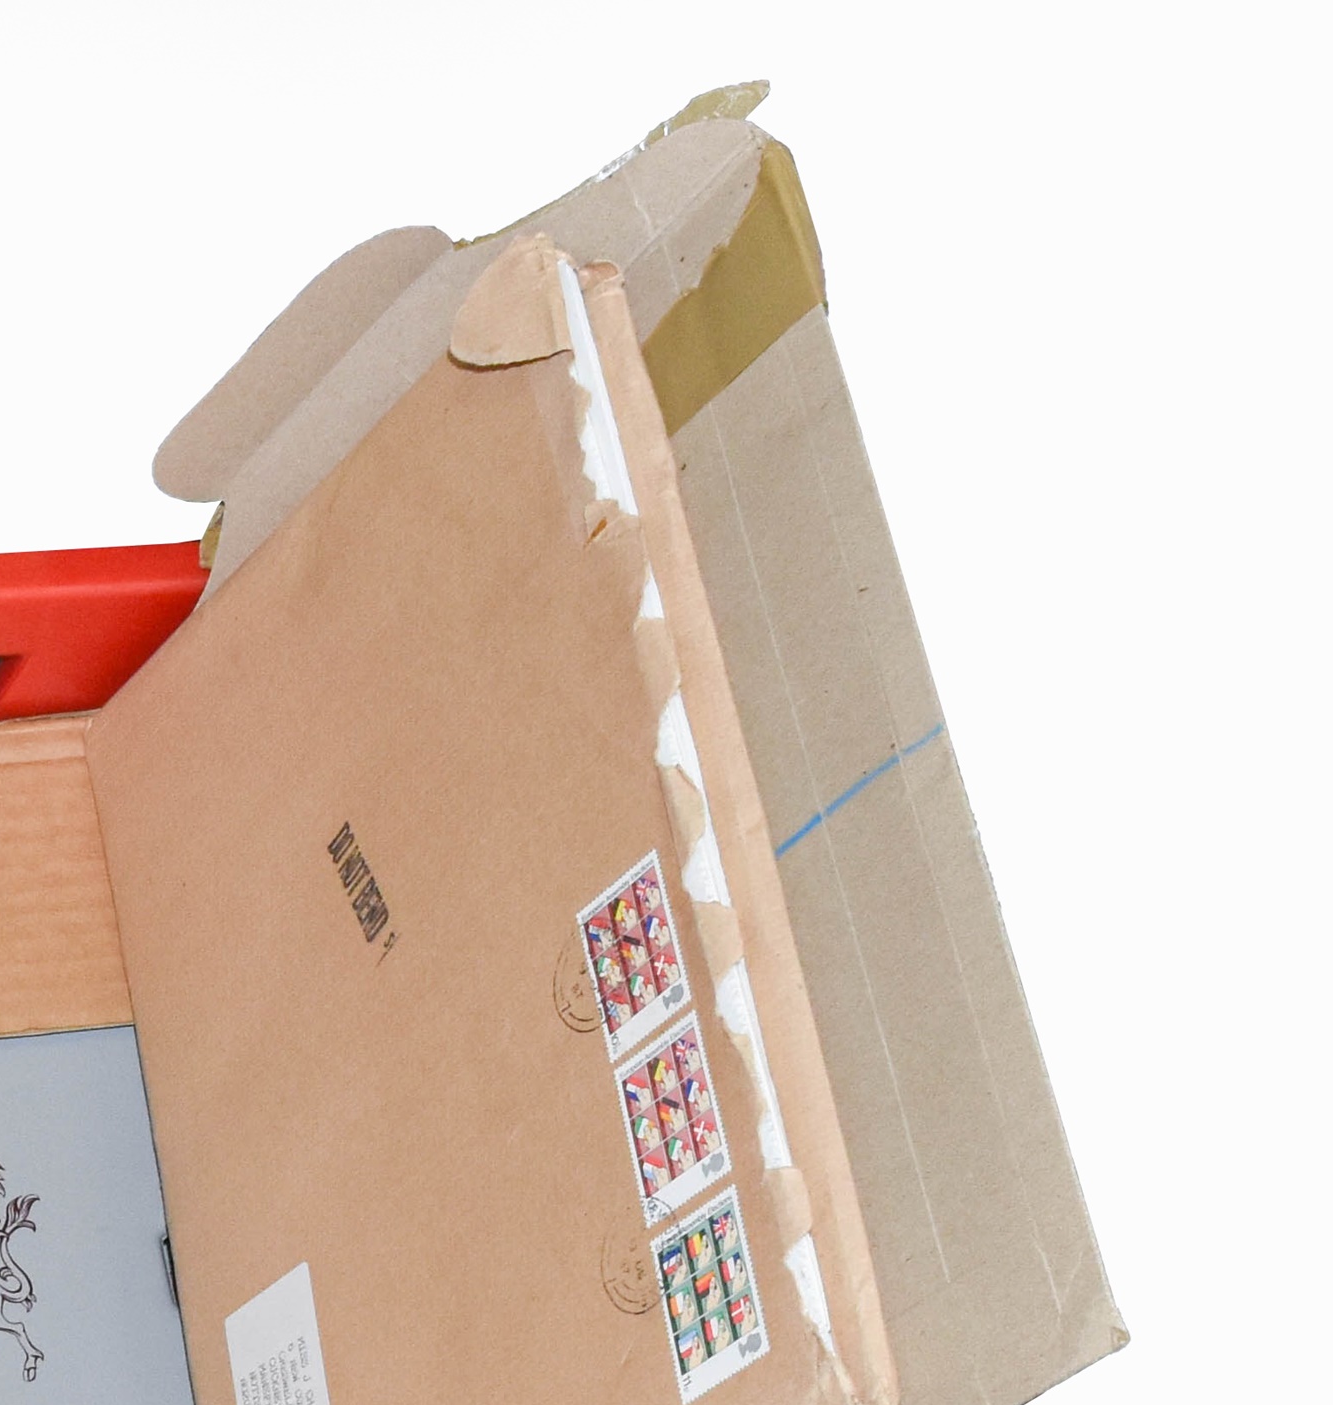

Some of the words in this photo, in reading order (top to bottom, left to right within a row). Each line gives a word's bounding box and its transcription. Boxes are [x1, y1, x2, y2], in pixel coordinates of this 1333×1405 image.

[327, 821, 354, 864] DO
[338, 844, 371, 896] NOT
[352, 876, 389, 943] BEND
